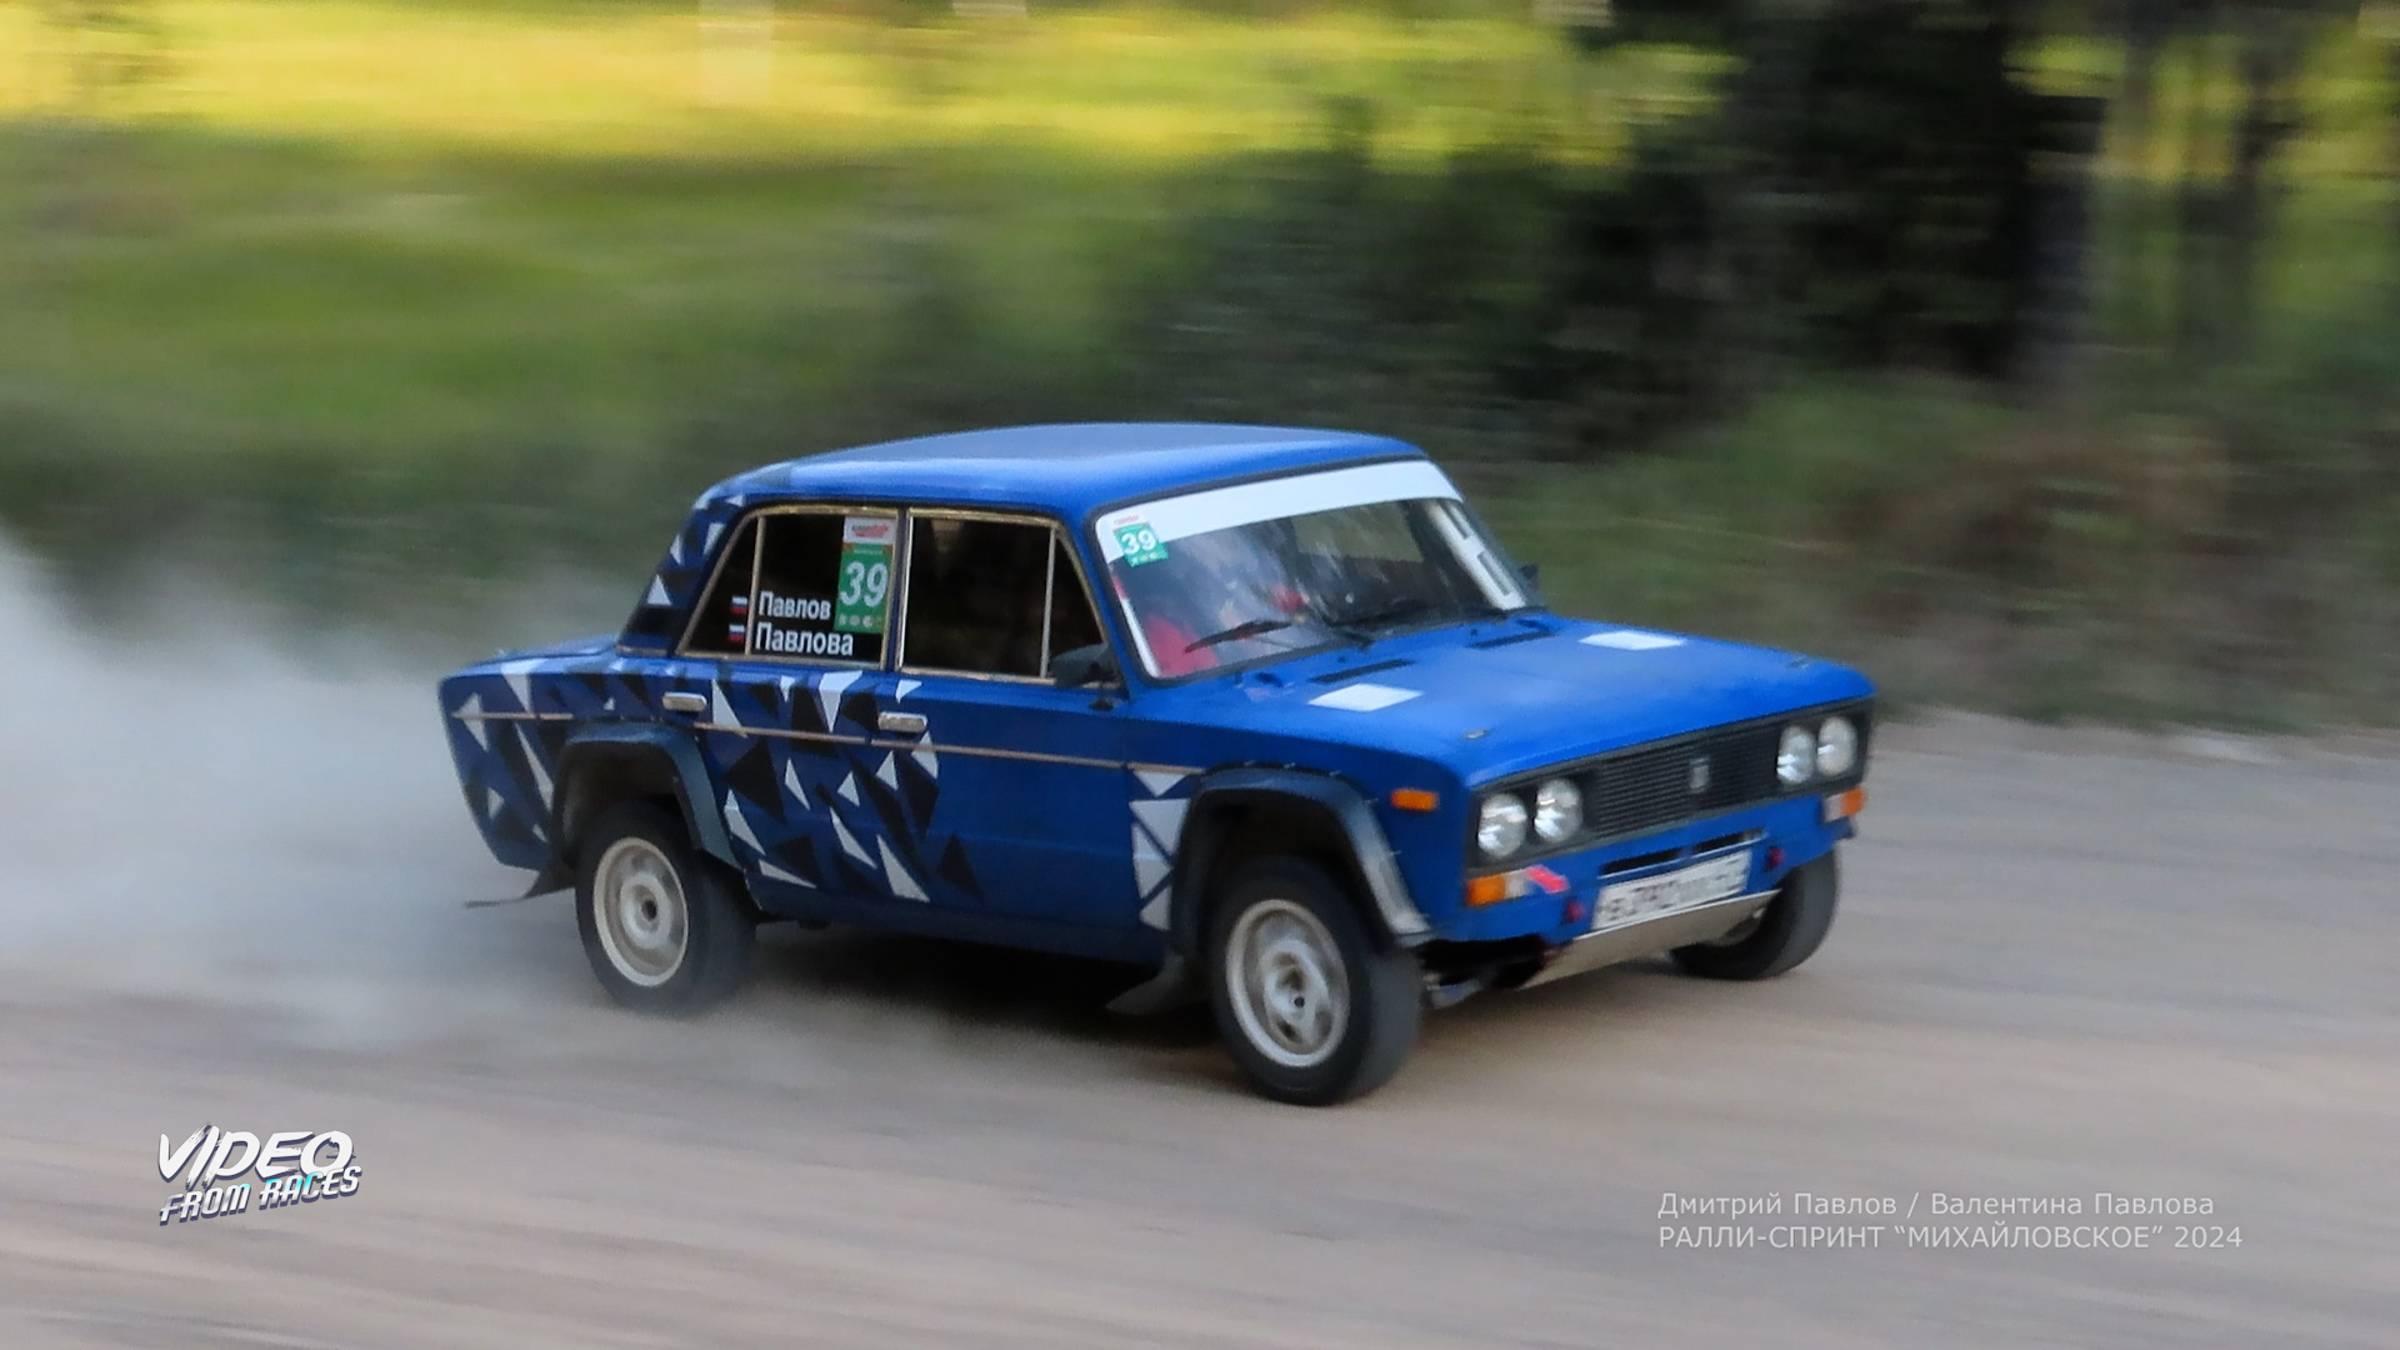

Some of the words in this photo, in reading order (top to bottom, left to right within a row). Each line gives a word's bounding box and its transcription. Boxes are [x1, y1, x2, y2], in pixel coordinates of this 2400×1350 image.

[1121, 530, 1156, 554] 39
[840, 561, 888, 607] 39
[759, 591, 831, 620] Павлов
[756, 621, 853, 656] Павлова
